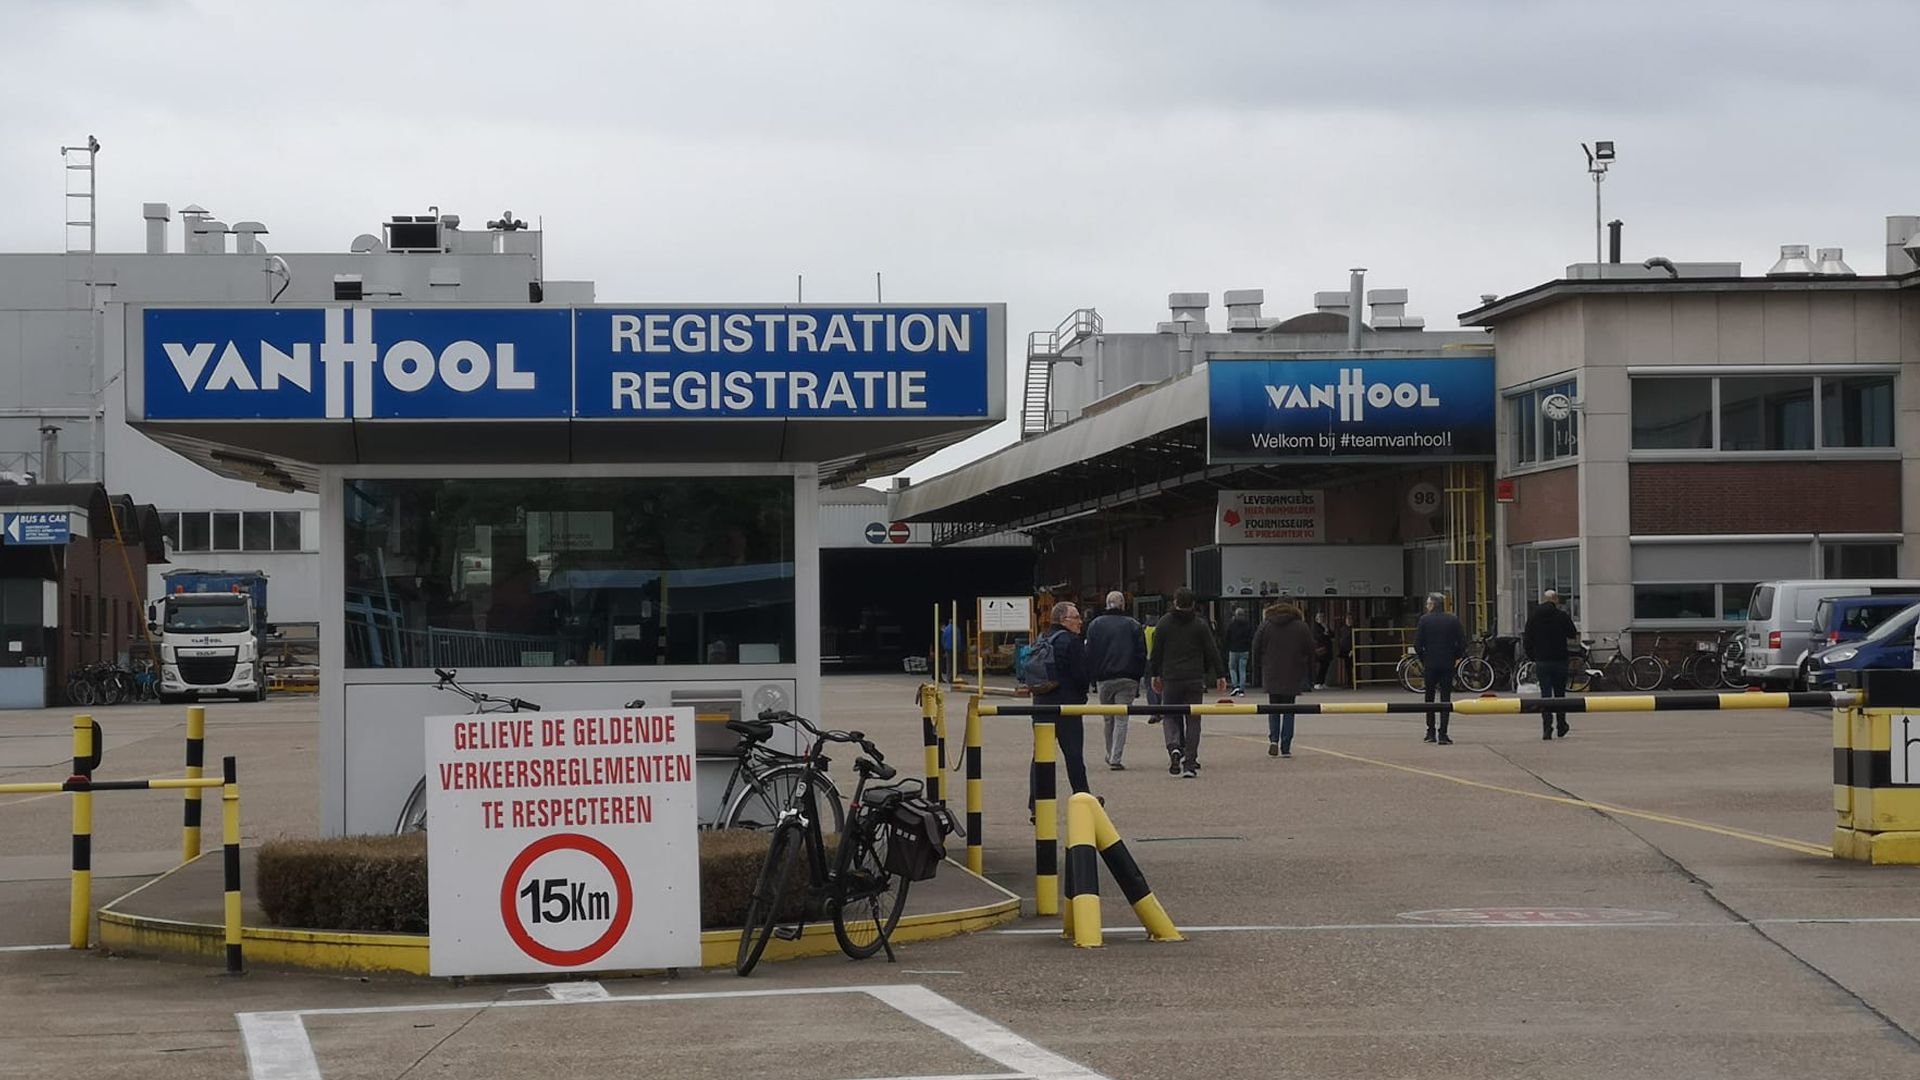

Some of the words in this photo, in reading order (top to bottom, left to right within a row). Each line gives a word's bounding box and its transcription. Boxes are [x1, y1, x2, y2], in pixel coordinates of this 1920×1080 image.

[611, 313, 970, 353] REGISTRATION
[611, 371, 928, 410] REGISTRATIE
[1251, 433, 1314, 448] Welkom
[1319, 433, 1336, 451] bij
[1340, 431, 1452, 448] #teamvanhool!
[1243, 495, 1315, 505] LEVERANCIERS
[1414, 491, 1435, 505] 98
[20, 515, 37, 524] BUS
[39, 515, 47, 523] &
[48, 514, 67, 523] CAR
[1245, 519, 1314, 529] FOURNISSEURS
[454, 720, 533, 750] GELIEVE
[542, 719, 566, 747] DE
[573, 715, 676, 746] GELDENDE
[439, 754, 692, 791] VERKEERSREGLEMENTEN
[482, 801, 504, 829] TE
[512, 796, 652, 828] RESPECTEREN
